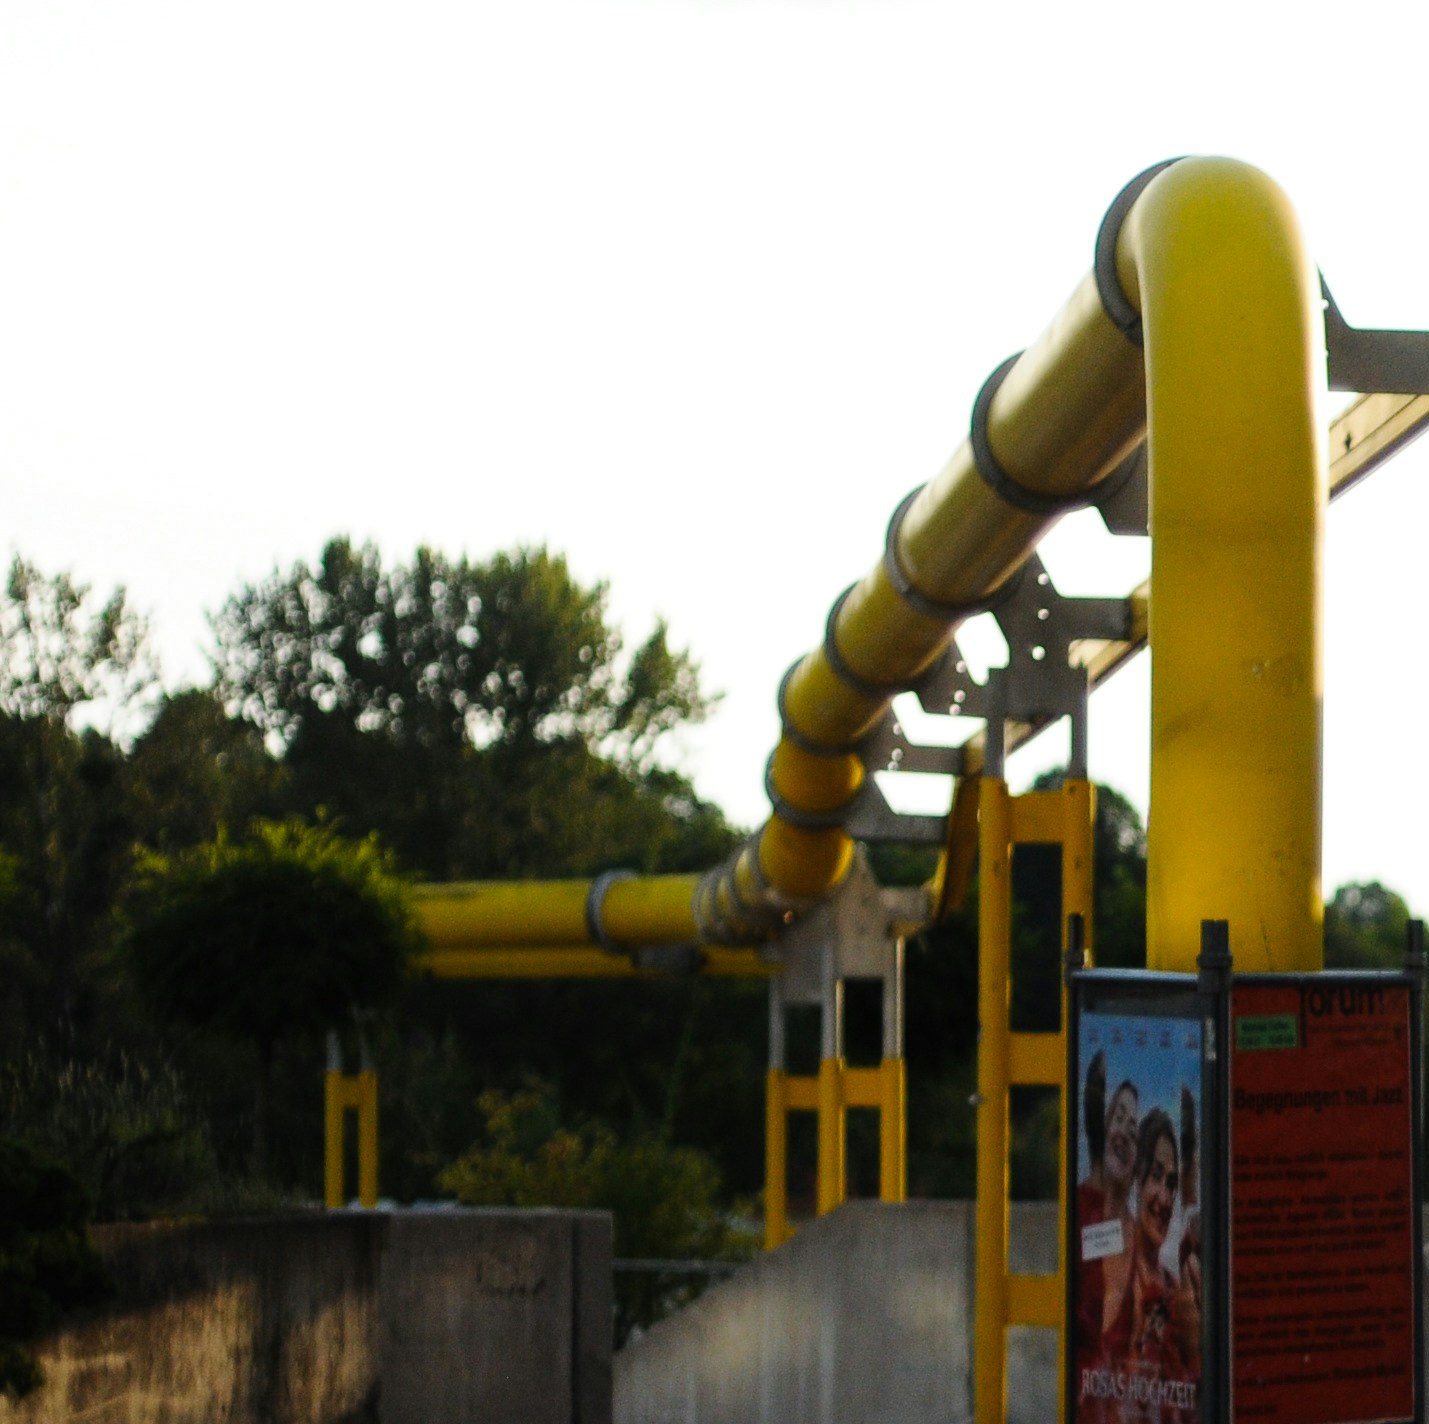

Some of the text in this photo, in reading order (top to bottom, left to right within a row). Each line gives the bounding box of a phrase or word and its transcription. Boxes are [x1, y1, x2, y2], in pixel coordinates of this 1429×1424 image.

[1234, 1087, 1340, 1114] Begegnungen
[1344, 1086, 1368, 1105] mit
[1081, 1367, 1125, 1400] ROSAS
[1128, 1375, 1198, 1410] HOCHZEIT
